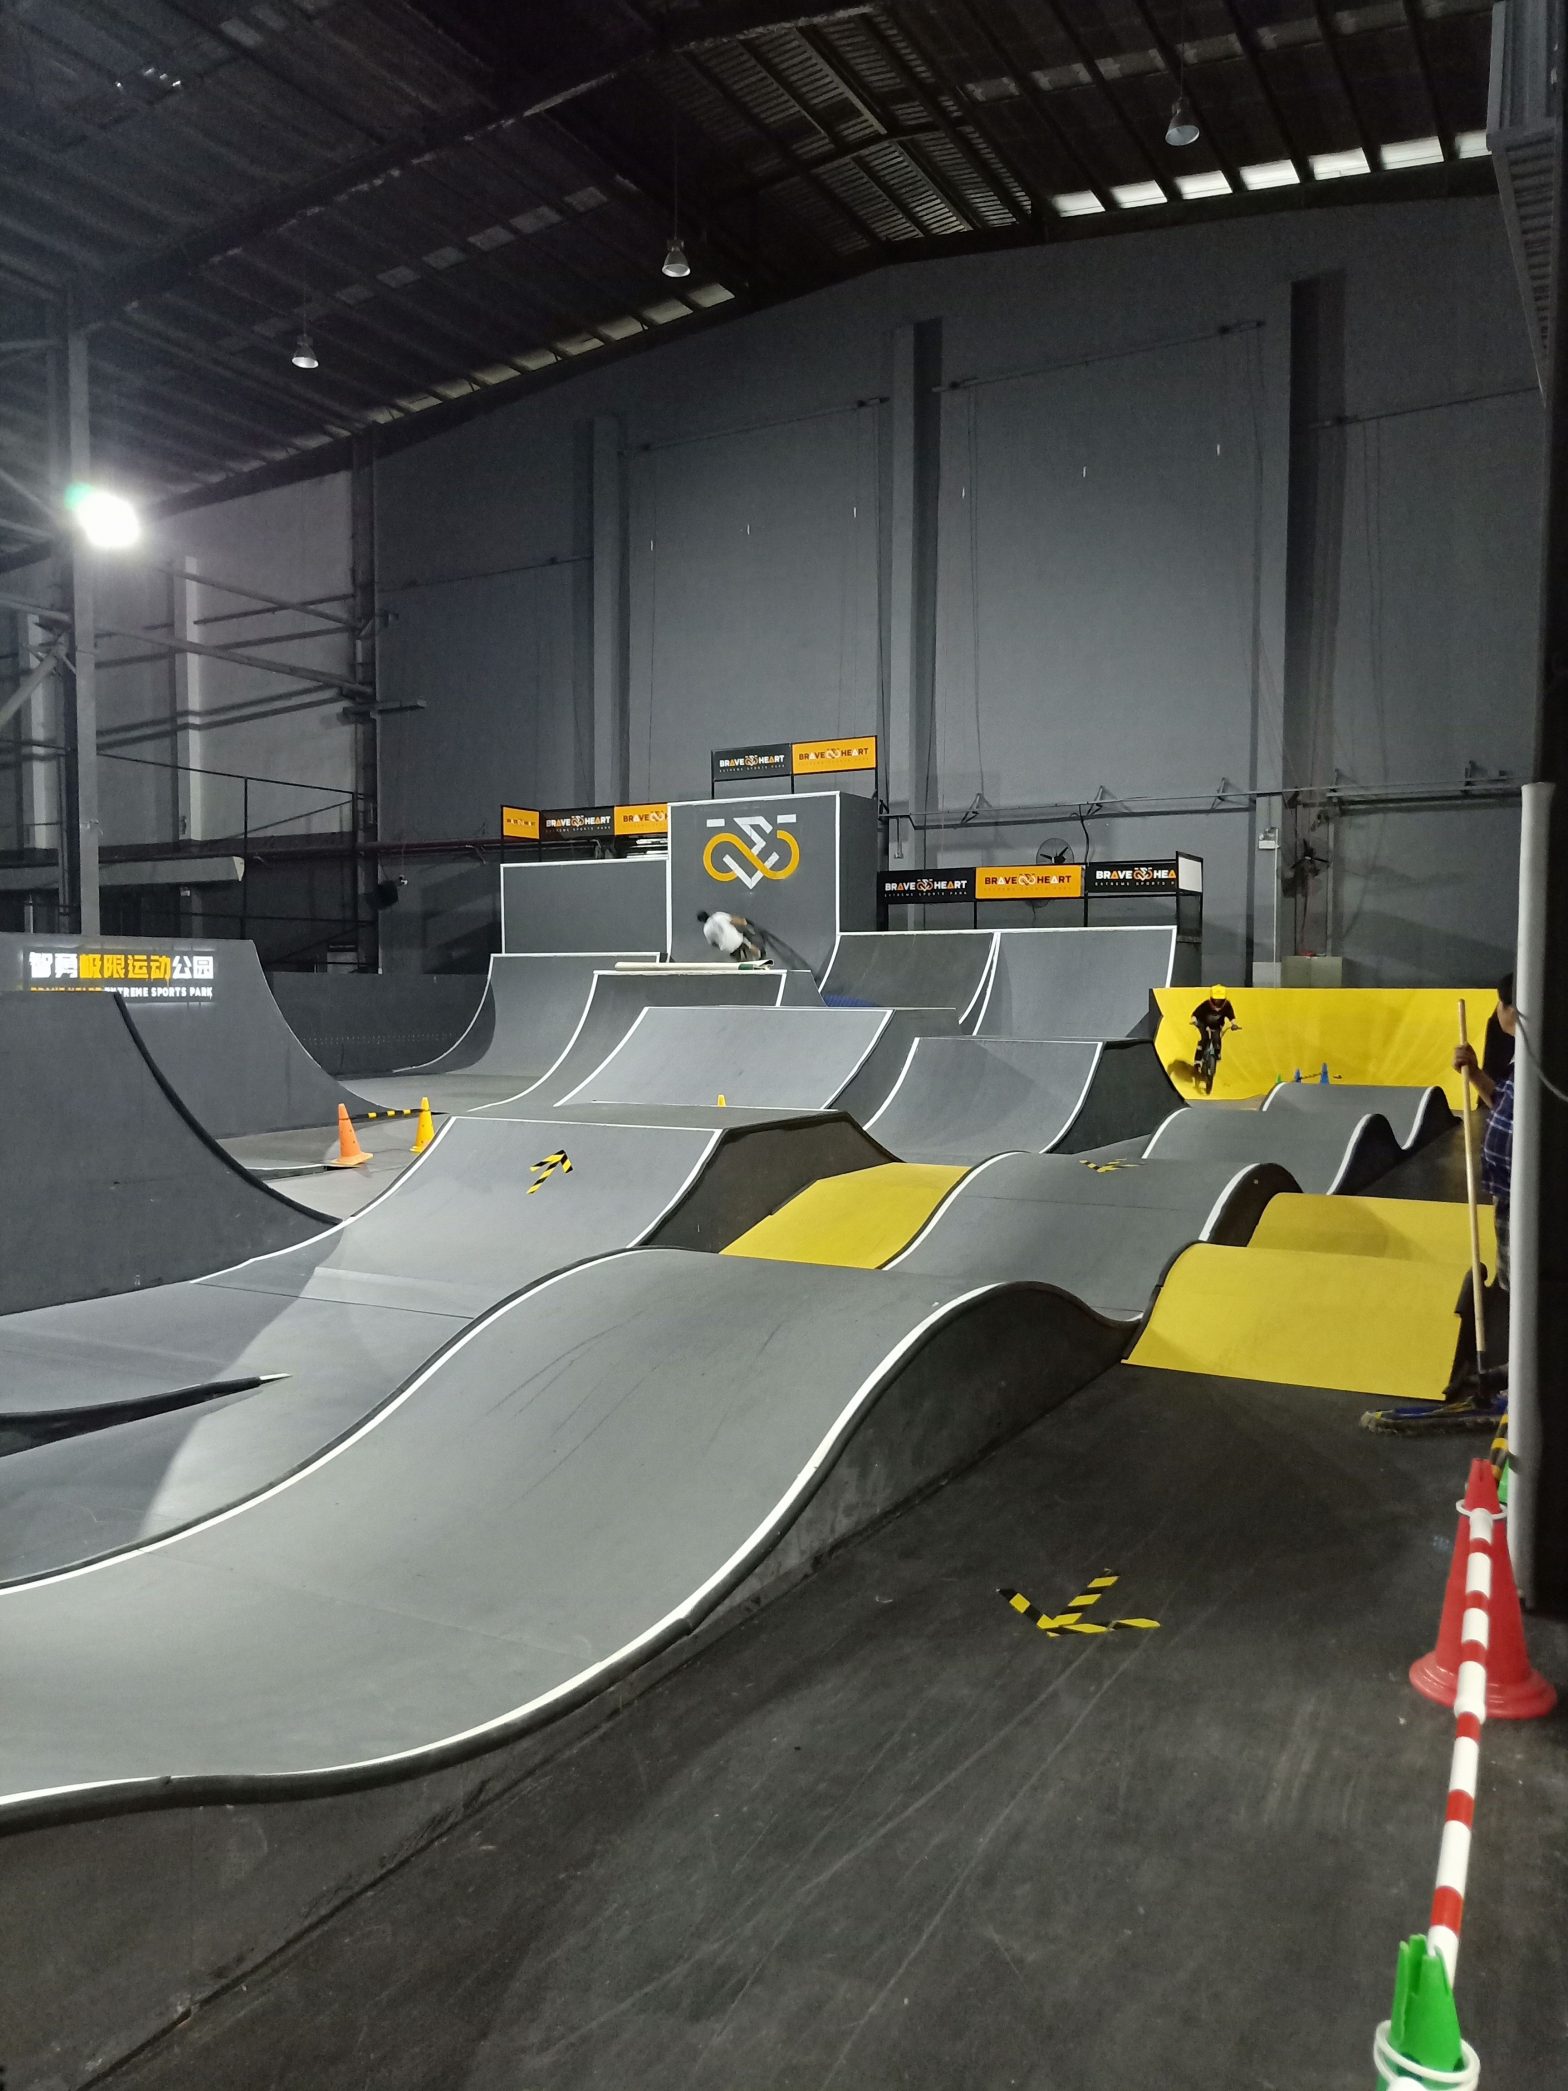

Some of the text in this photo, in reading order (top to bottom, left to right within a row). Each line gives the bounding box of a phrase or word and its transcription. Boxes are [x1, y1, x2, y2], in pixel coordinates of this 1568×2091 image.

[798, 748, 868, 761] BRAVE HEART
[719, 755, 785, 767] BRAVE HEART
[546, 816, 611, 827] BRAVE HEART
[623, 814, 649, 822] BRAVE
[984, 875, 1071, 885] BRAVE HEART
[1096, 870, 1133, 879] BRAVE
[885, 880, 967, 891] BRAVE HEART
[150, 986, 187, 997] SPORTS
[189, 986, 213, 998] PARK
